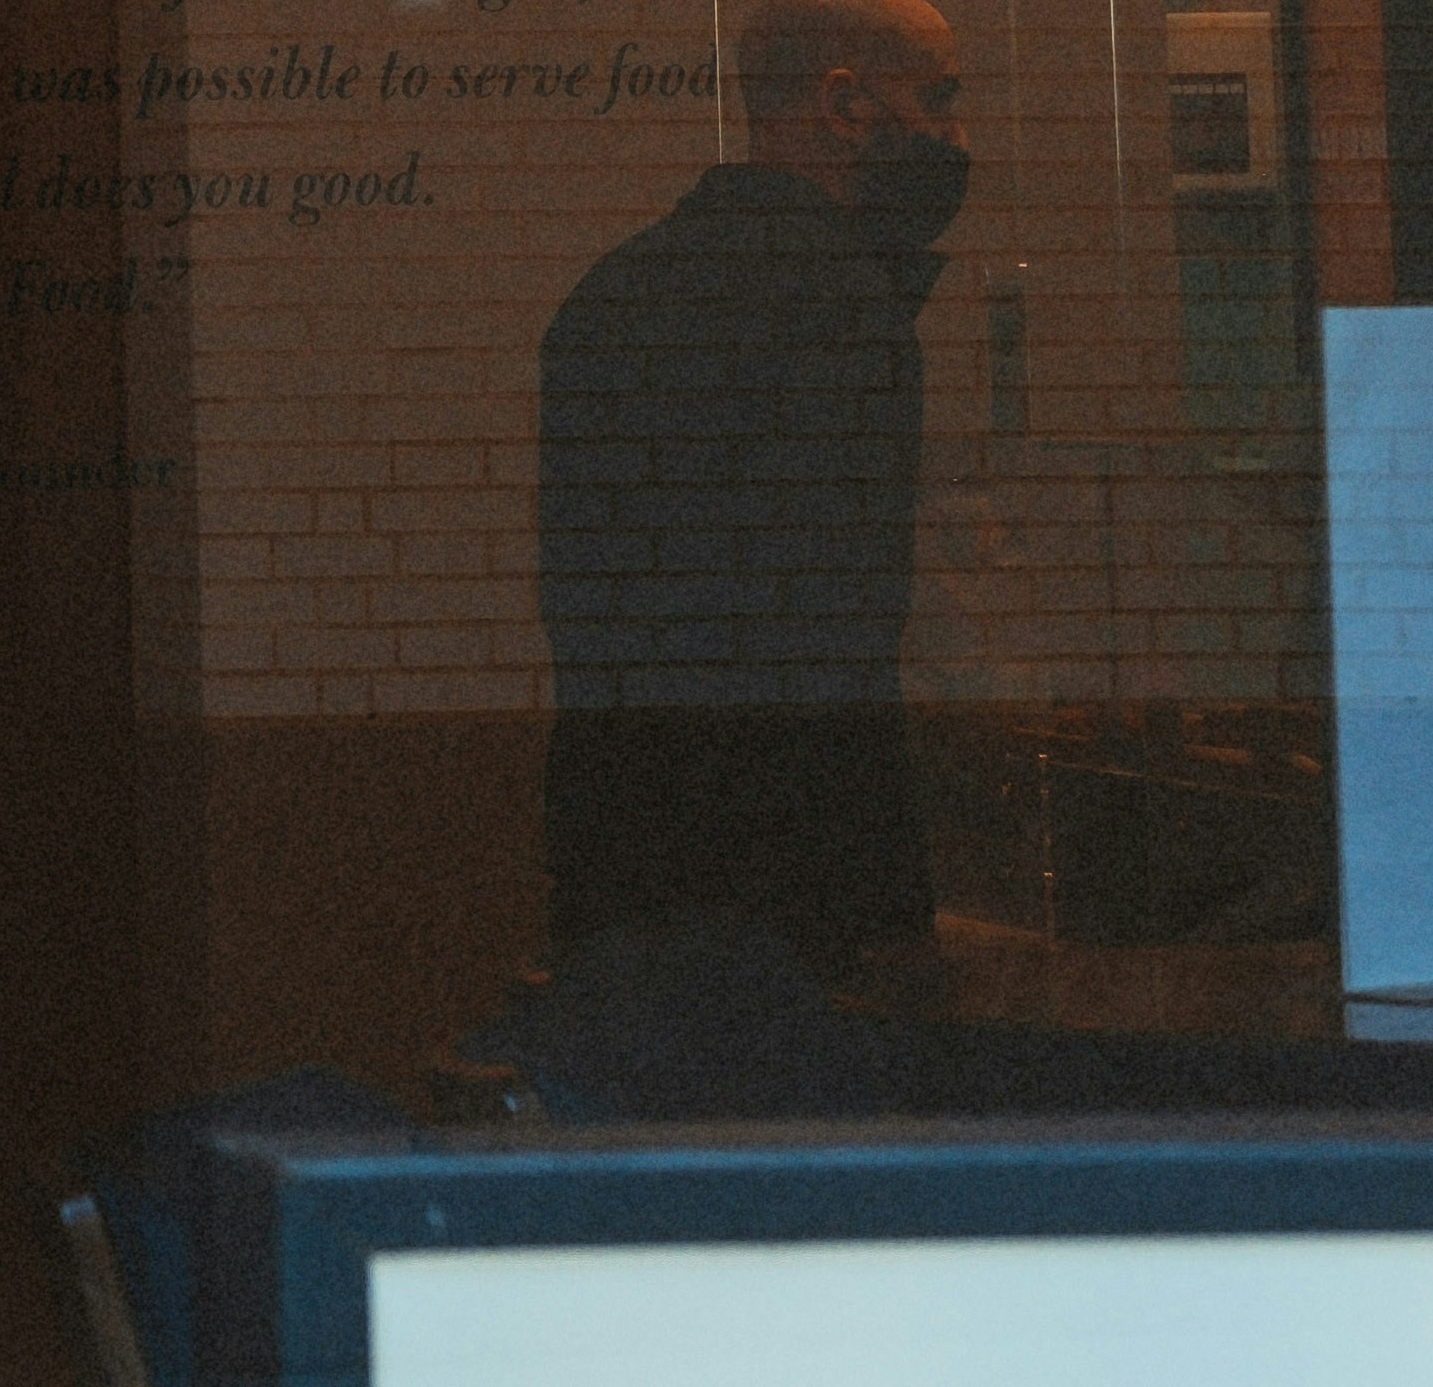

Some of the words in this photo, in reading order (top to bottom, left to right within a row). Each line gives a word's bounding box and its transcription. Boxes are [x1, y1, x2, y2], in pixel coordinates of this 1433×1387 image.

[9, 61, 123, 106] was
[137, 45, 361, 120] possible
[378, 50, 431, 98] to
[444, 61, 591, 100] serve
[33, 155, 155, 213] does
[159, 173, 271, 228] you
[287, 150, 436, 226] good.
